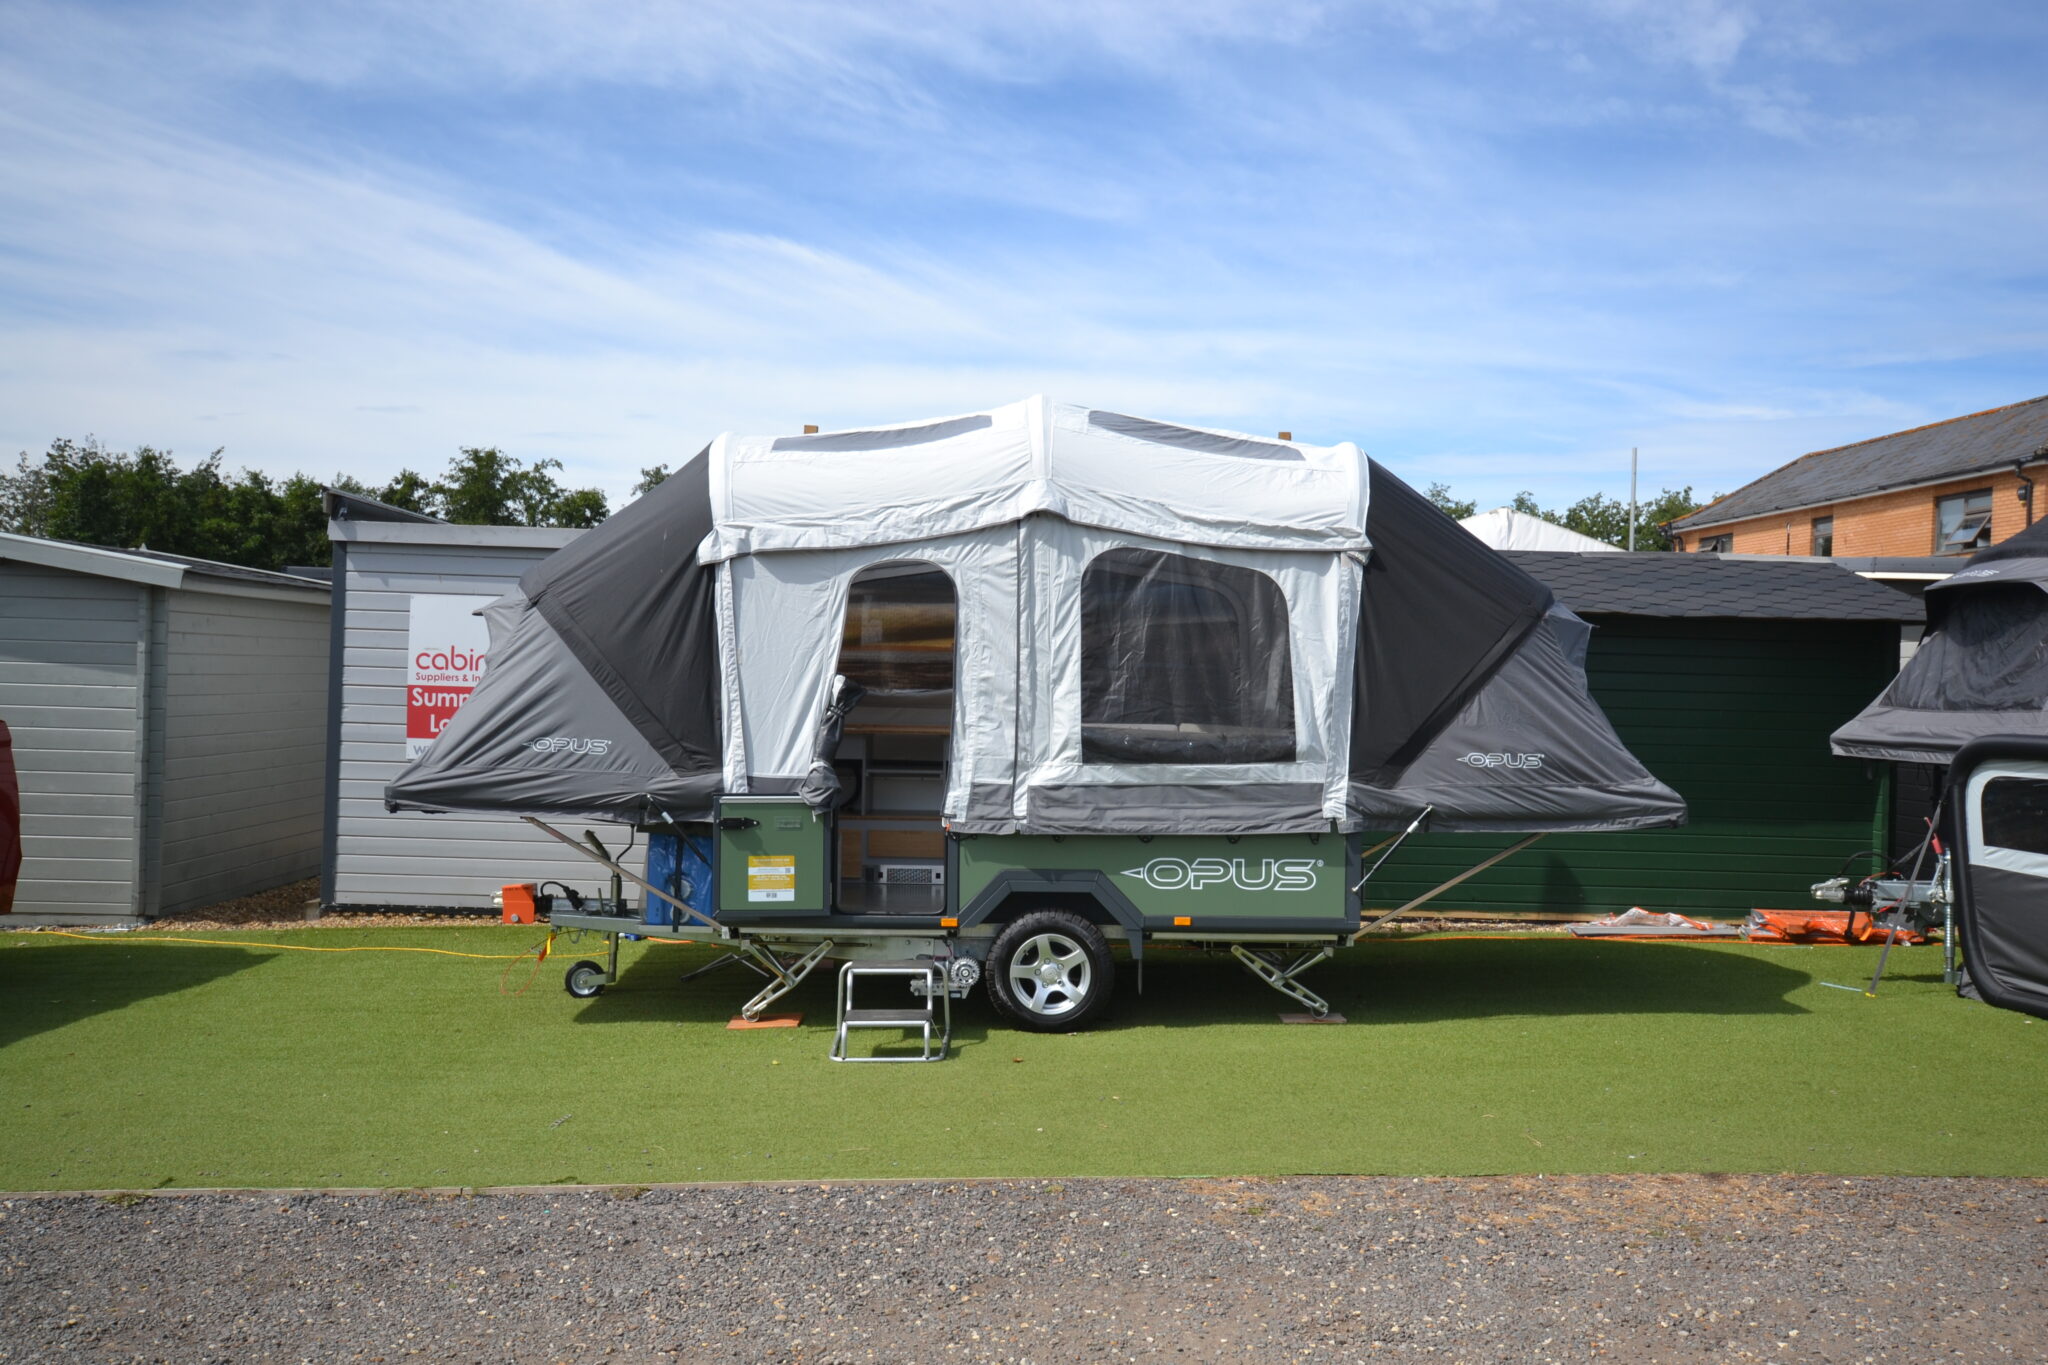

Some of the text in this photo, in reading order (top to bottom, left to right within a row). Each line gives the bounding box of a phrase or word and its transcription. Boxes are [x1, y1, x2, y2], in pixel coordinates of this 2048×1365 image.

[415, 672, 459, 683] Suppliers
[462, 674, 469, 682] &
[532, 737, 608, 755] OPUS
[1466, 752, 1542, 769] OPUS
[1144, 857, 1317, 891] OPUS
